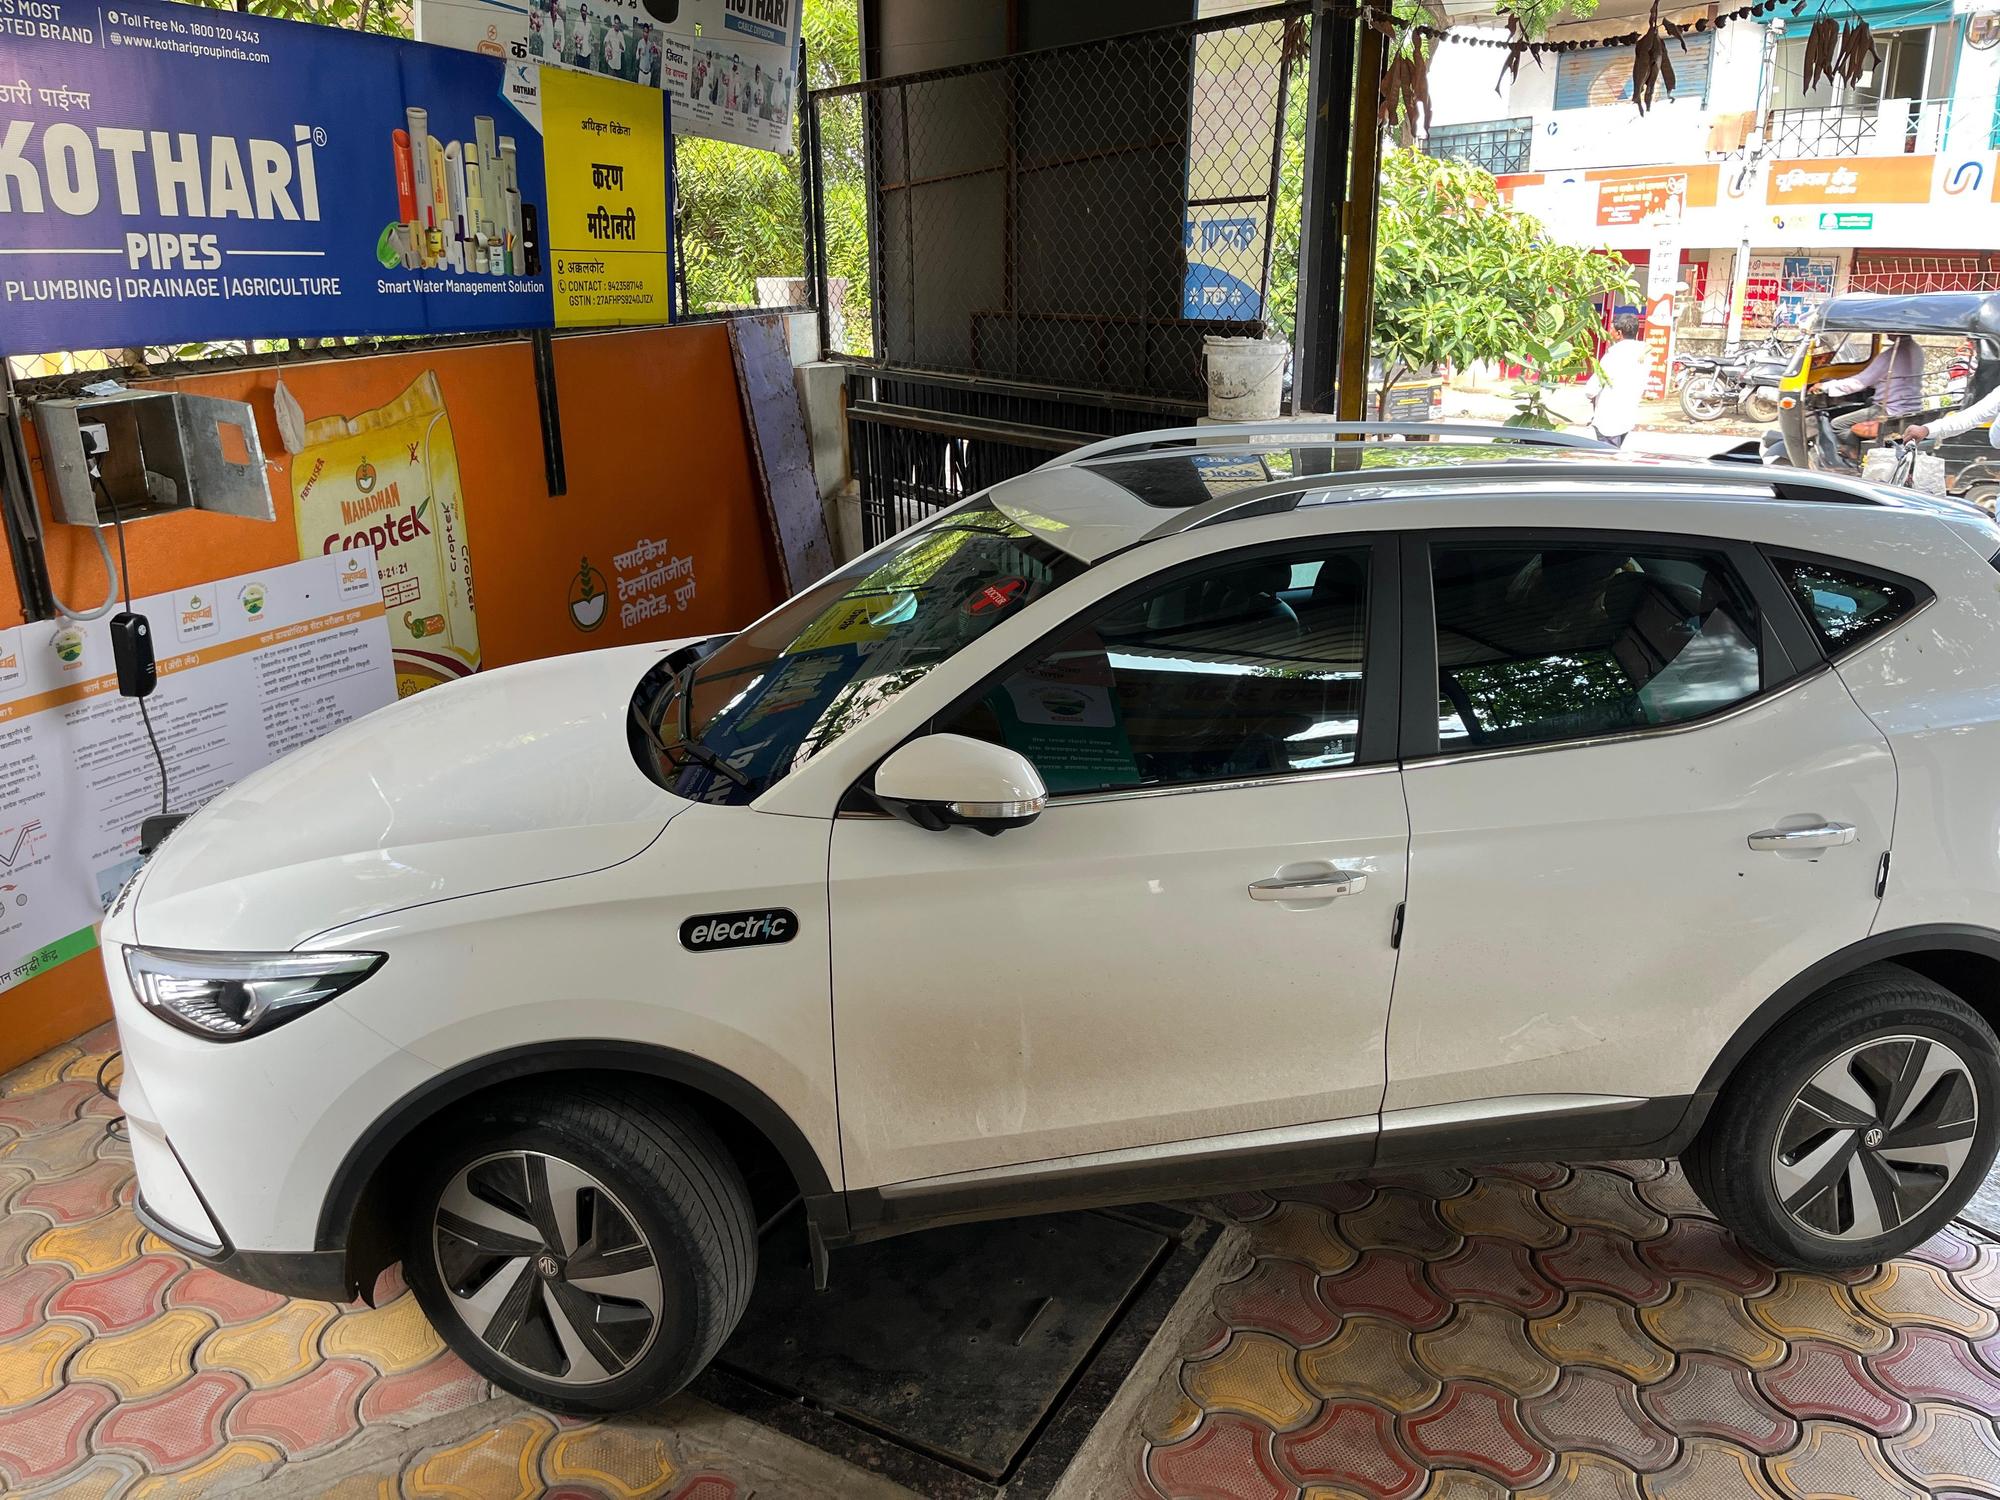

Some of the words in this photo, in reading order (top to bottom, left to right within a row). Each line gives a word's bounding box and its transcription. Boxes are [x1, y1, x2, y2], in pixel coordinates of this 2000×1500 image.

[18, 1, 60, 21] MOST
[40, 22, 93, 44] BRAND
[120, 12, 142, 28] Toll
[144, 16, 168, 32] Free
[171, 20, 188, 35] No.
[190, 24, 214, 38] 1800
[216, 27, 233, 40] 120
[235, 30, 260, 44] 4343
[123, 35, 270, 64] www.kotharigroupindia.com
[38, 84, 91, 111] पाईप्स
[581, 117, 608, 136] अधिकृत
[610, 121, 631, 136] विक्रेता
[591, 163, 624, 191] करण
[587, 205, 636, 240] मशिनरी
[126, 232, 222, 270] PIPES
[568, 257, 605, 274] अक्कलकोट
[6, 277, 112, 302] PLUMBING
[126, 277, 220, 298] DRAINAGE
[232, 277, 341, 297] AGRICULTURE
[377, 279, 411, 293] Smart
[413, 279, 444, 293] Water
[446, 279, 507, 296] Management
[508, 280, 545, 293] Solution
[568, 280, 602, 292] CONTACT
[569, 295, 591, 306] GSTIN
[341, 481, 401, 527] MAHADHAN
[674, 577, 696, 612] पुणे
[690, 913, 787, 944] electric
